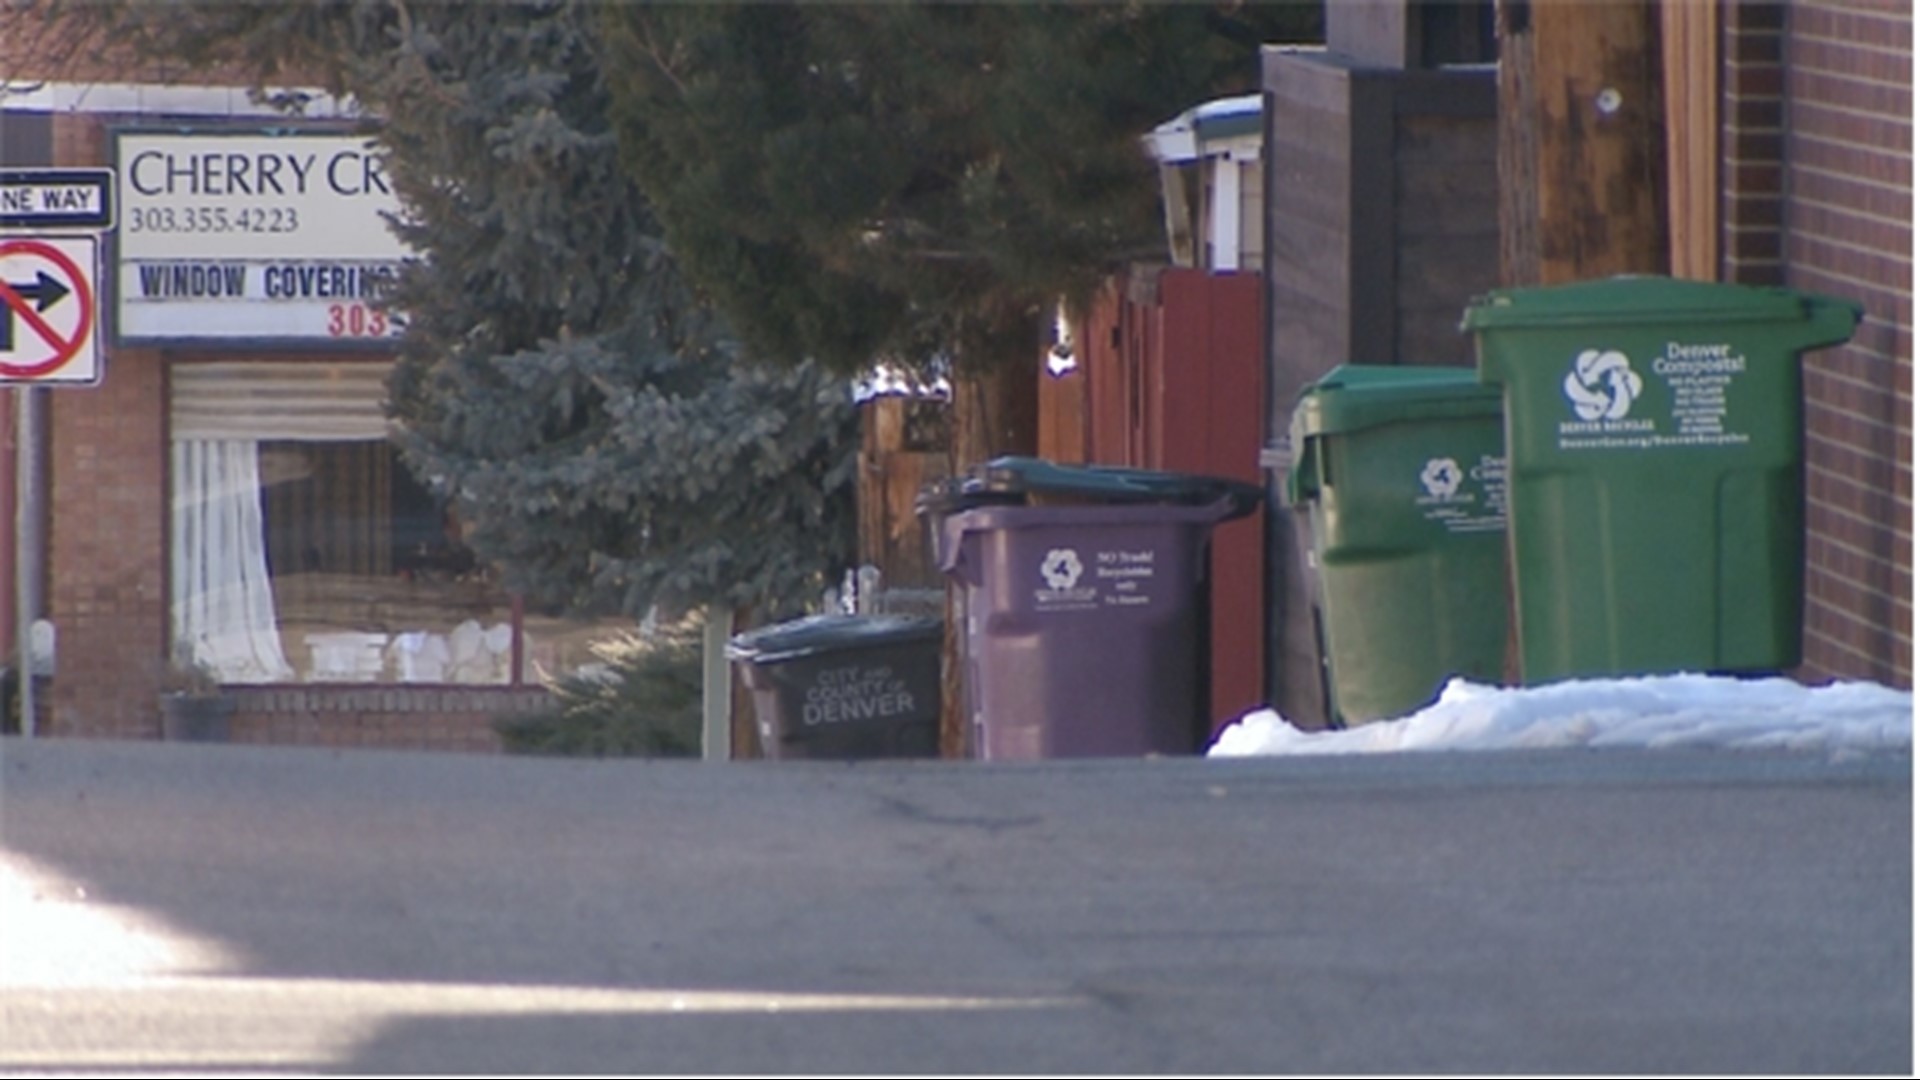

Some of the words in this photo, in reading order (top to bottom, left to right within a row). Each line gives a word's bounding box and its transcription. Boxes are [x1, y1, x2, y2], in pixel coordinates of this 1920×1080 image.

[130, 151, 316, 195] CHERRY
[327, 151, 391, 195] CR
[1, 188, 33, 212] NE
[43, 188, 92, 209] WAY
[130, 207, 299, 233] 303.355.4223
[139, 265, 246, 297] WINDOW
[1667, 342, 1731, 360] Denver
[1653, 355, 1746, 375] Composts!
[817, 666, 858, 685] CITY
[806, 680, 883, 702] COUNTY
[803, 691, 915, 725] DENVER
